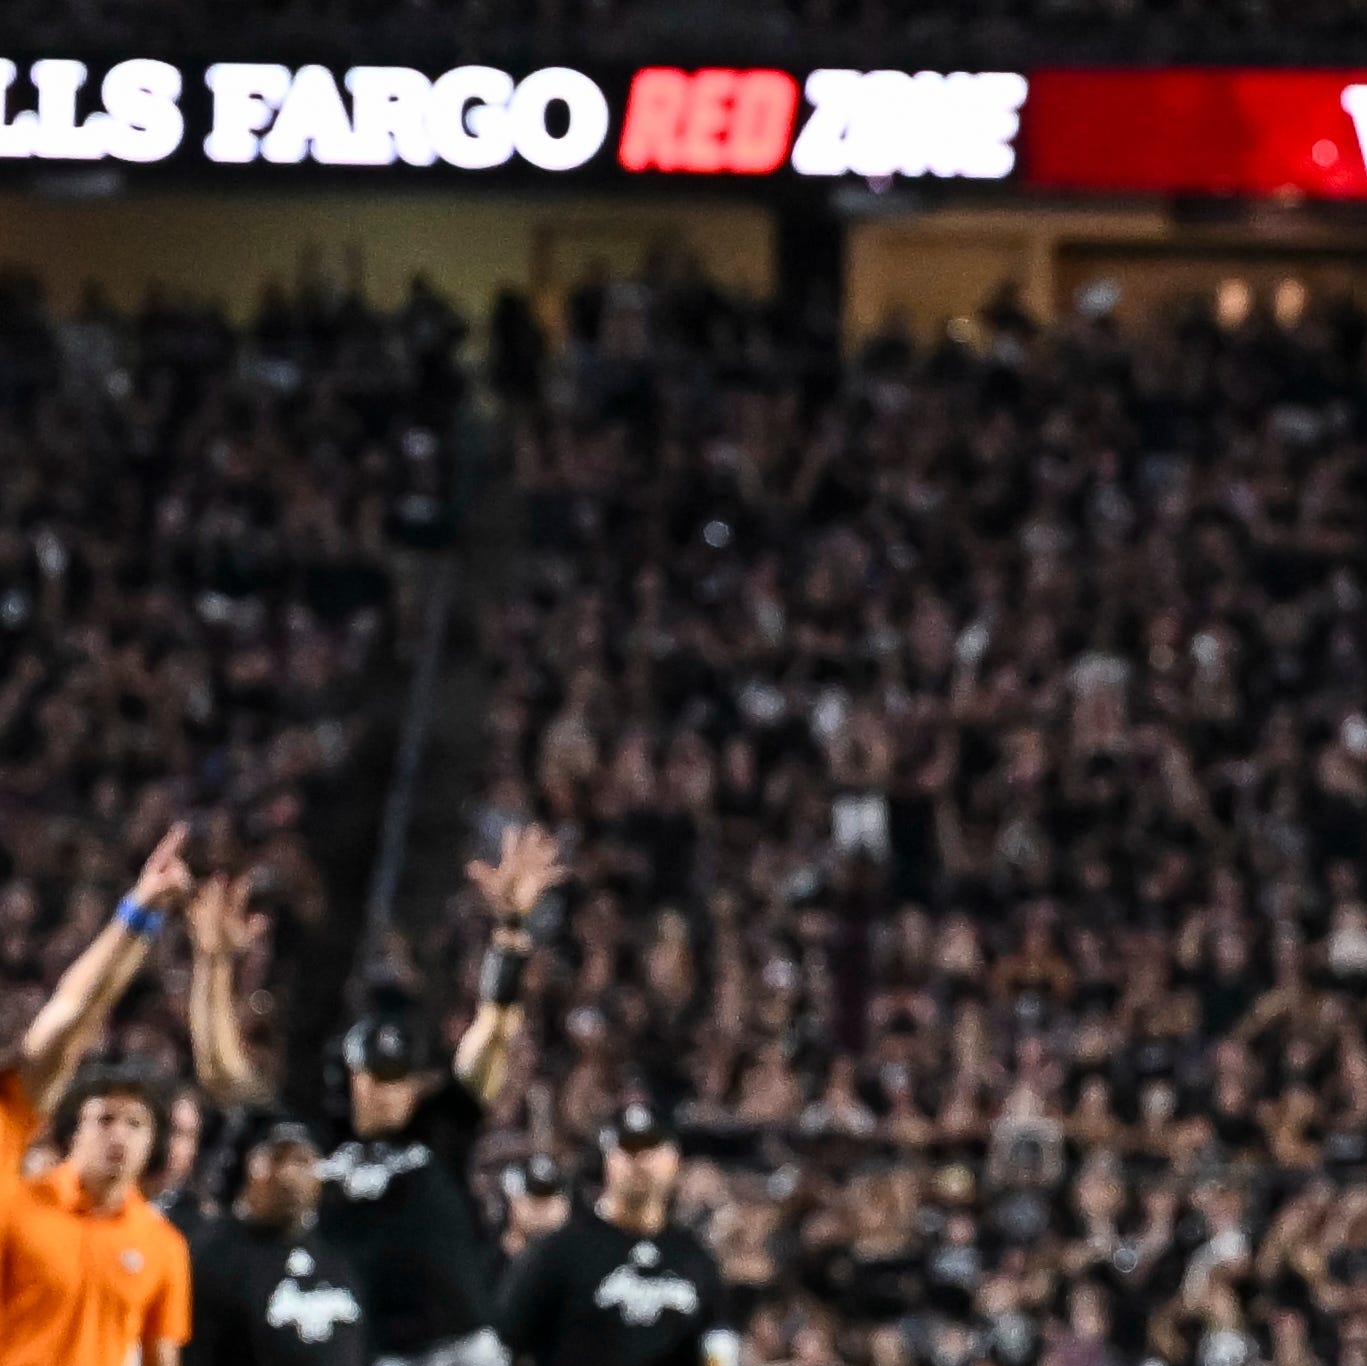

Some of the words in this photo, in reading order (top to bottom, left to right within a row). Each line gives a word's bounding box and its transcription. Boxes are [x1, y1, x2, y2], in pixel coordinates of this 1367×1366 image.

[204, 63, 608, 170] FARGO
[619, 67, 798, 174] RED
[792, 69, 1027, 178] ZONE
